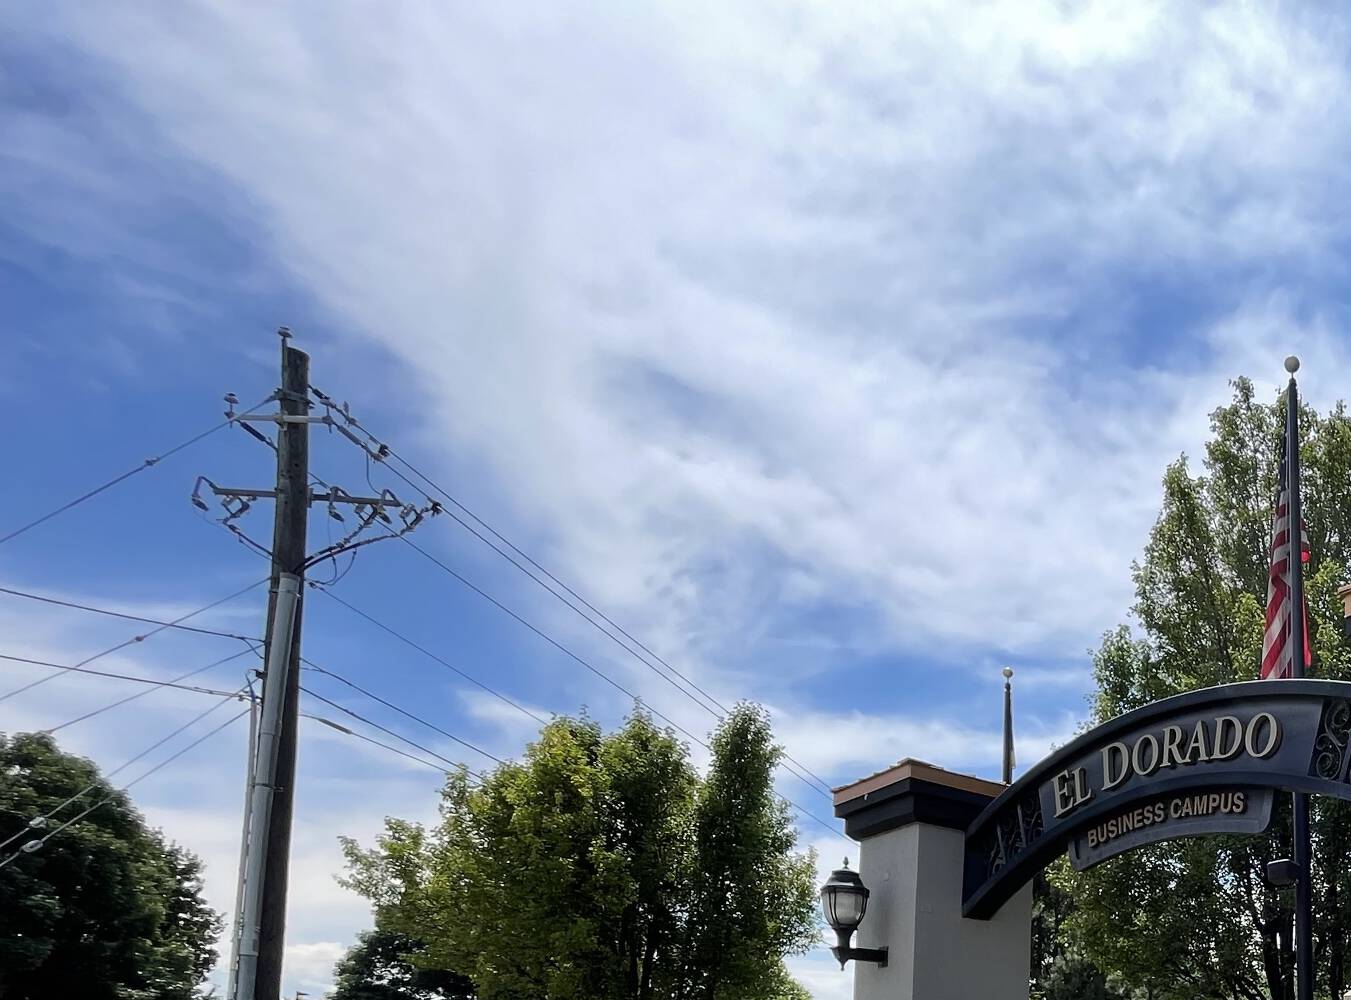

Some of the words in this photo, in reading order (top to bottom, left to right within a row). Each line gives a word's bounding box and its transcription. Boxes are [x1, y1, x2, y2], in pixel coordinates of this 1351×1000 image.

[1050, 767, 1093, 819] EL
[1100, 711, 1279, 791] DORADO
[1086, 804, 1164, 848] BUSINESS
[1170, 792, 1245, 818] CAMPUS
